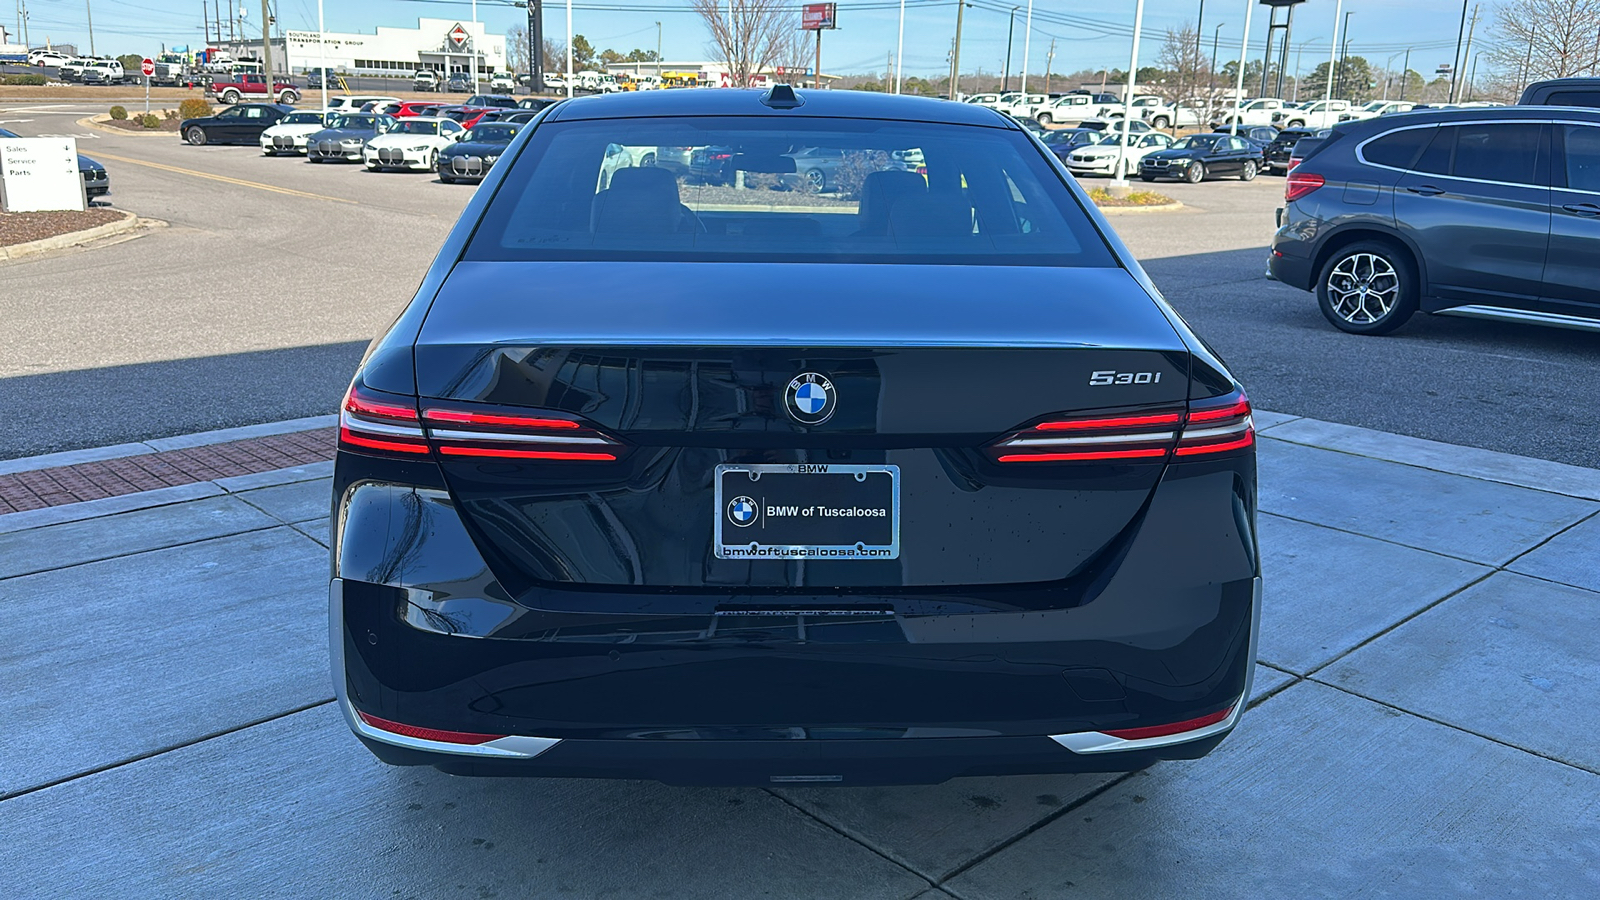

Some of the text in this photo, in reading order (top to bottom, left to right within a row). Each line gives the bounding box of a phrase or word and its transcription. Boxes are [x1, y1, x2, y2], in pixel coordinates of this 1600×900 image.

[289, 37, 341, 45] TRANSPORATION
[142, 63, 154, 71] STOP
[6, 145, 28, 153] Sales
[790, 374, 832, 391] BMW
[798, 464, 829, 474] BMW
[766, 506, 887, 518] BMW of Tuscaloosa
[722, 547, 892, 557] bmwoftuscaloosa.com
